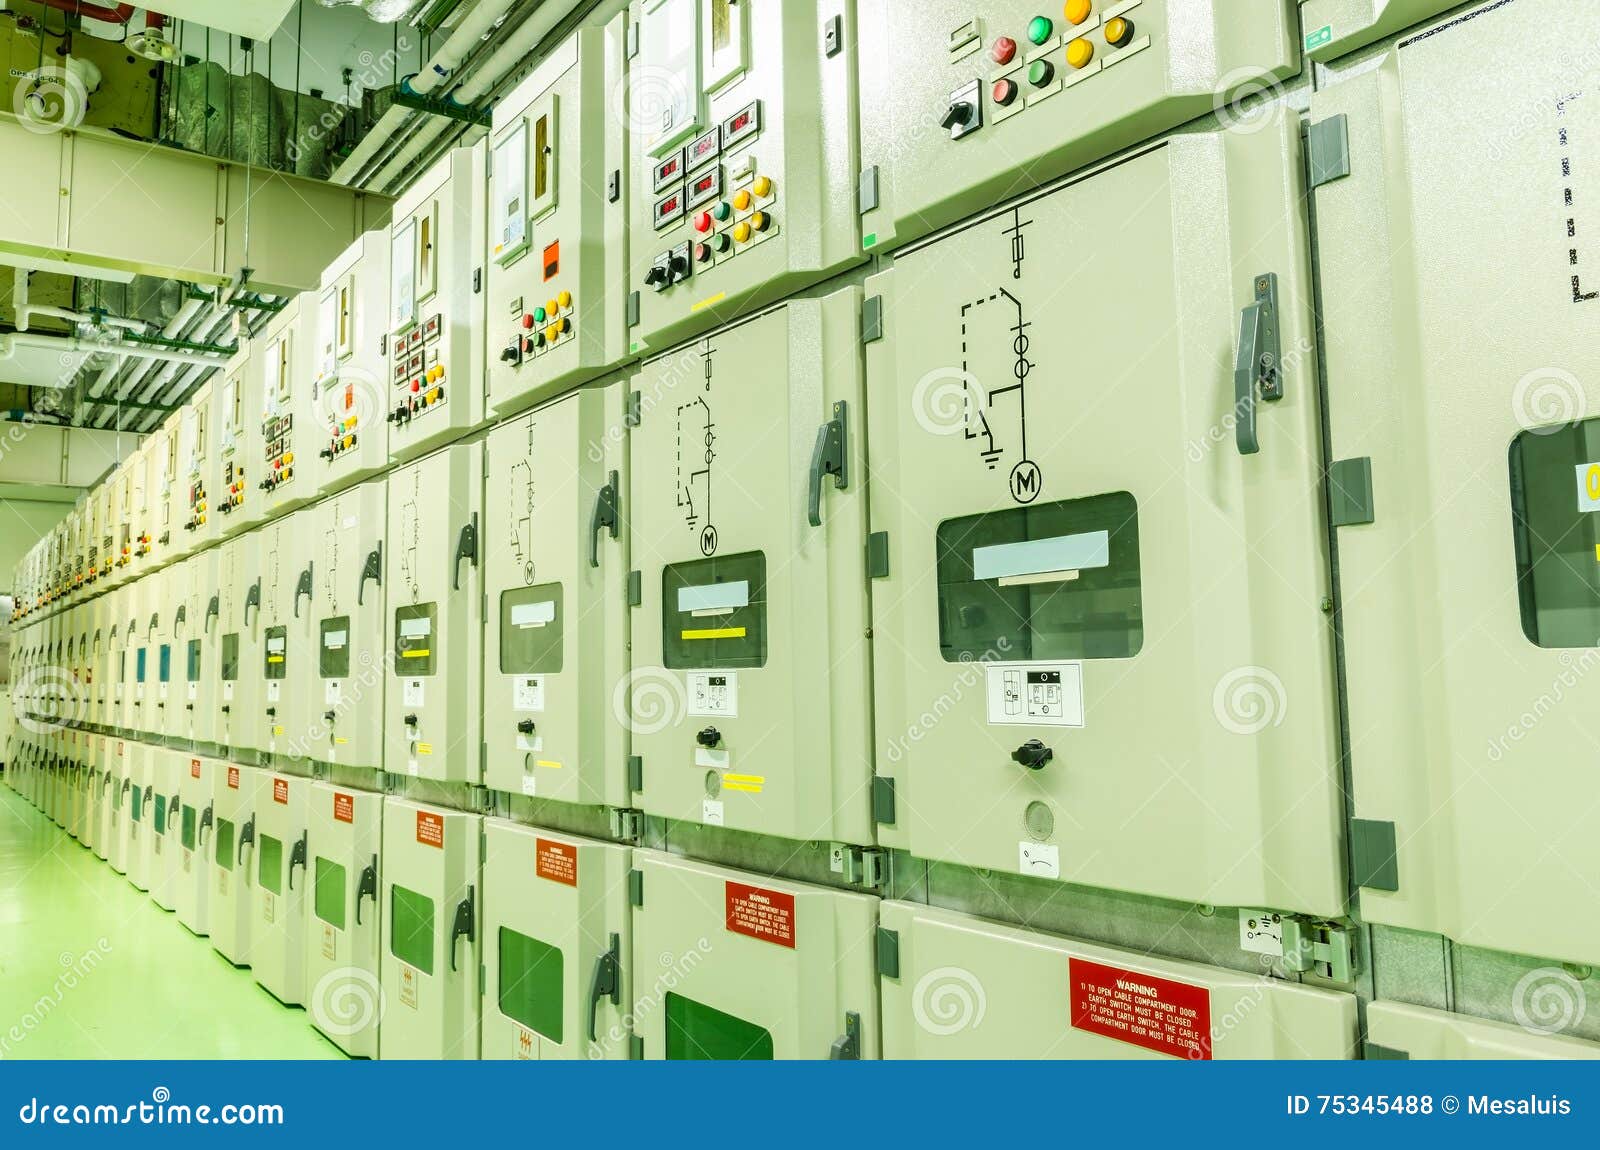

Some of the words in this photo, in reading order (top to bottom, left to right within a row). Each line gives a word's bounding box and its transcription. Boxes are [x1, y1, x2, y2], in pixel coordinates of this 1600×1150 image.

[1017, 468, 1035, 495] M
[704, 532, 714, 550] M
[1088, 984, 1096, 993] TO
[1097, 986, 1112, 997] OPEN
[1114, 991, 1132, 1003] CABLE
[1134, 996, 1177, 1014] COMPARTMENT
[1116, 979, 1157, 998] WARNING
[1088, 994, 1107, 1006] EARTH
[1109, 999, 1132, 1012] SWITCH
[1134, 1005, 1151, 1017] MUST
[1154, 1010, 1164, 1021] BE
[1090, 1003, 1097, 1013] TO
[1099, 1006, 1114, 1017] OPEN
[1116, 1010, 1135, 1023] EARTH
[1164, 1023, 1176, 1034] THE
[1178, 1027, 1200, 1041] CABLE
[1090, 1013, 1128, 1031] COMPARTMENT
[1131, 1024, 1147, 1036] DOOR
[1148, 1029, 1164, 1041] MUST
[1166, 1034, 1175, 1044] BE
